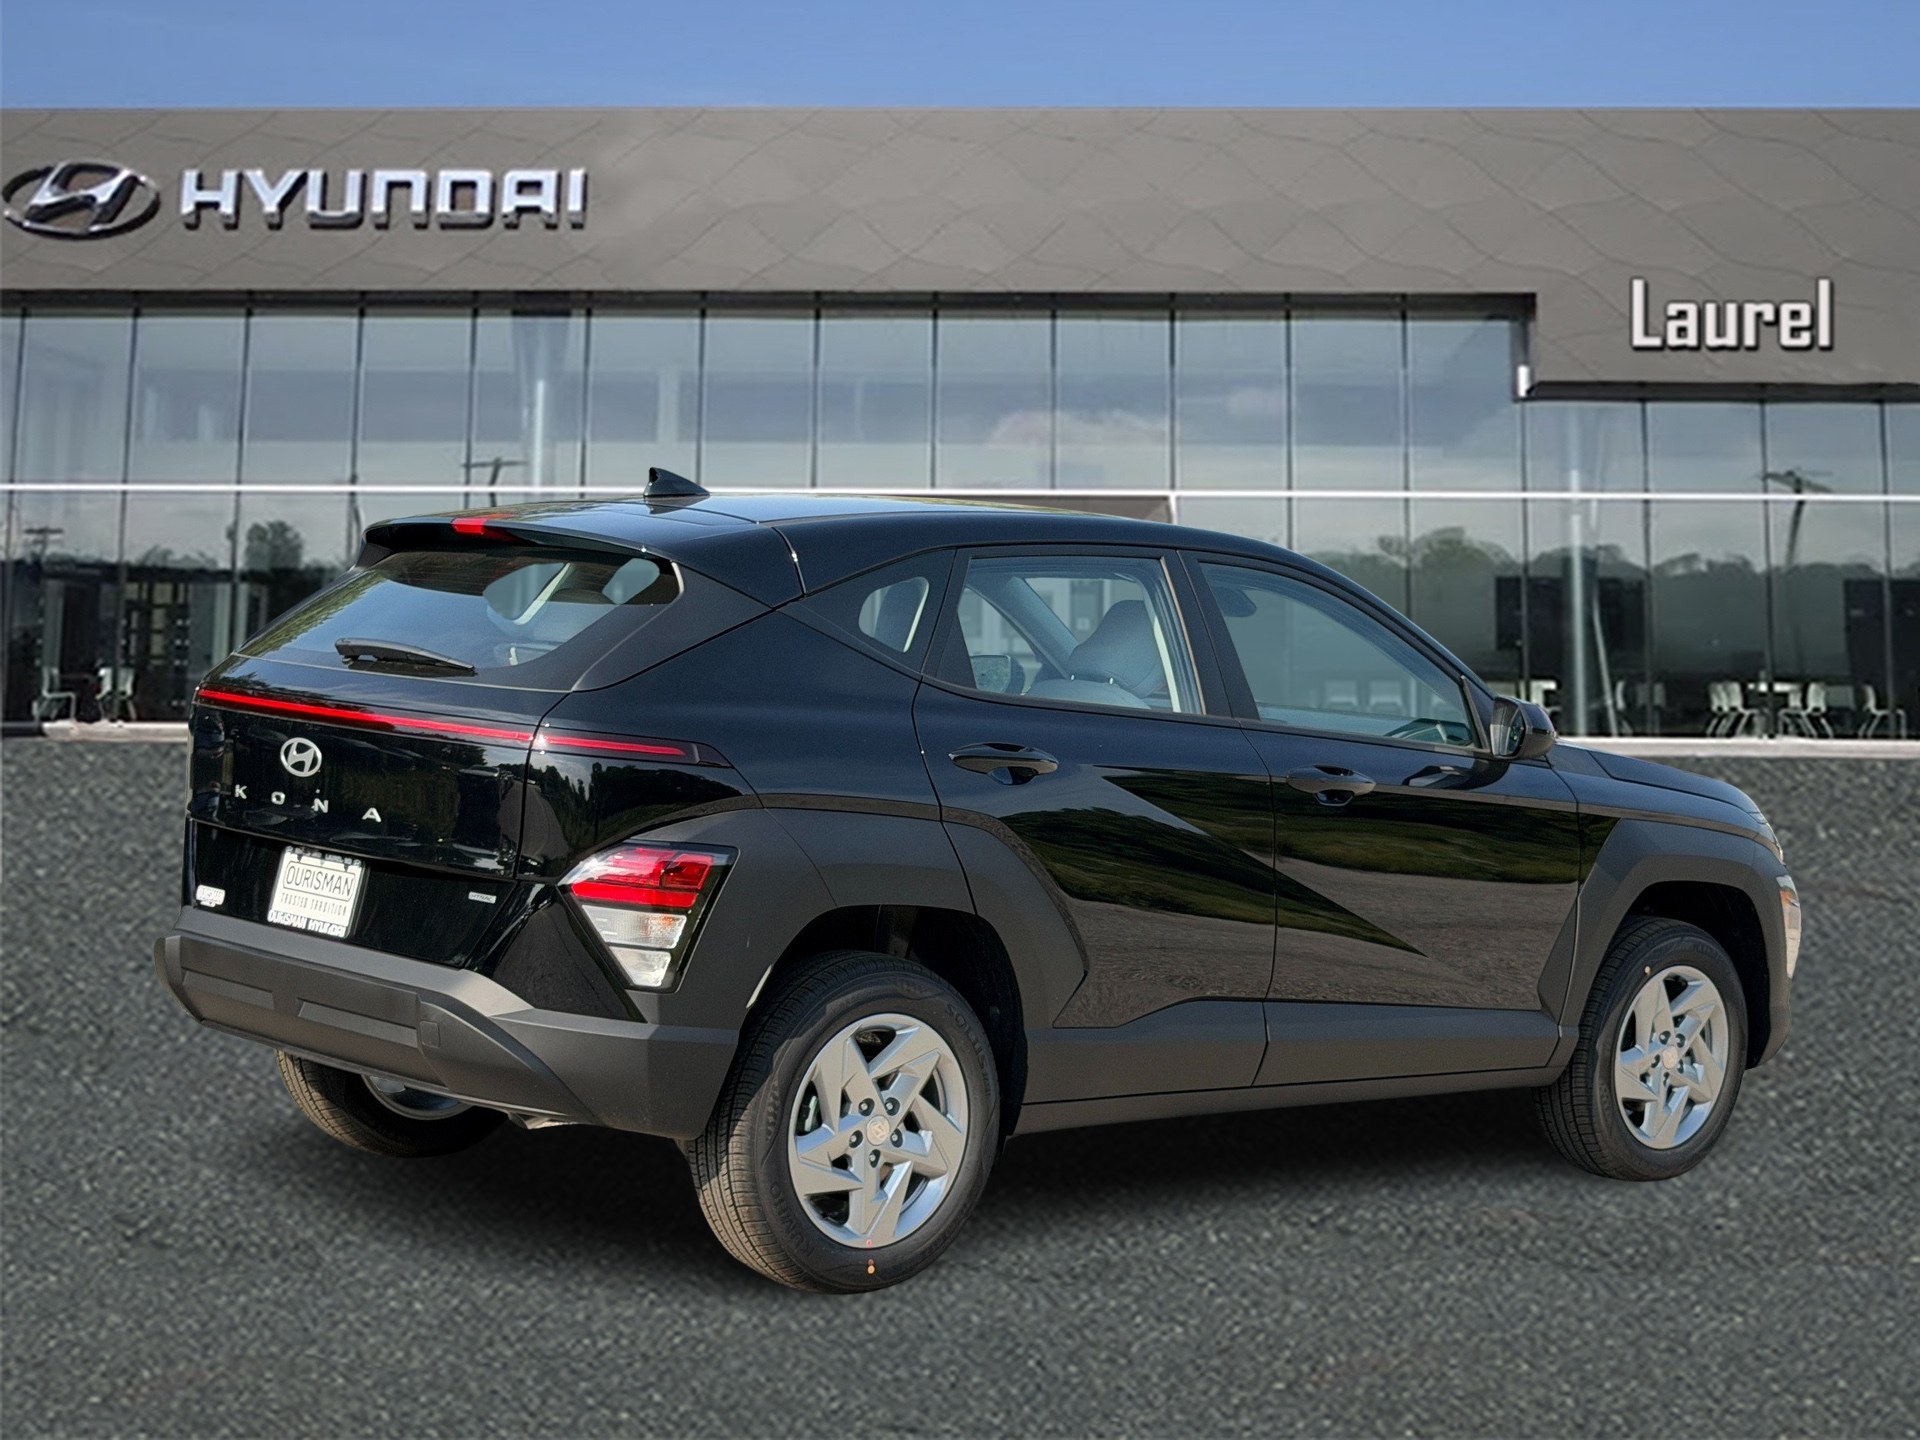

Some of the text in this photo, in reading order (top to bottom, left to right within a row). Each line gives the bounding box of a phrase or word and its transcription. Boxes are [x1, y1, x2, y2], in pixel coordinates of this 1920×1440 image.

[180, 168, 588, 230] HYUNDAI
[1631, 278, 1832, 349] Laurel
[234, 784, 382, 823] KONA
[286, 865, 355, 897] OURISMAN
